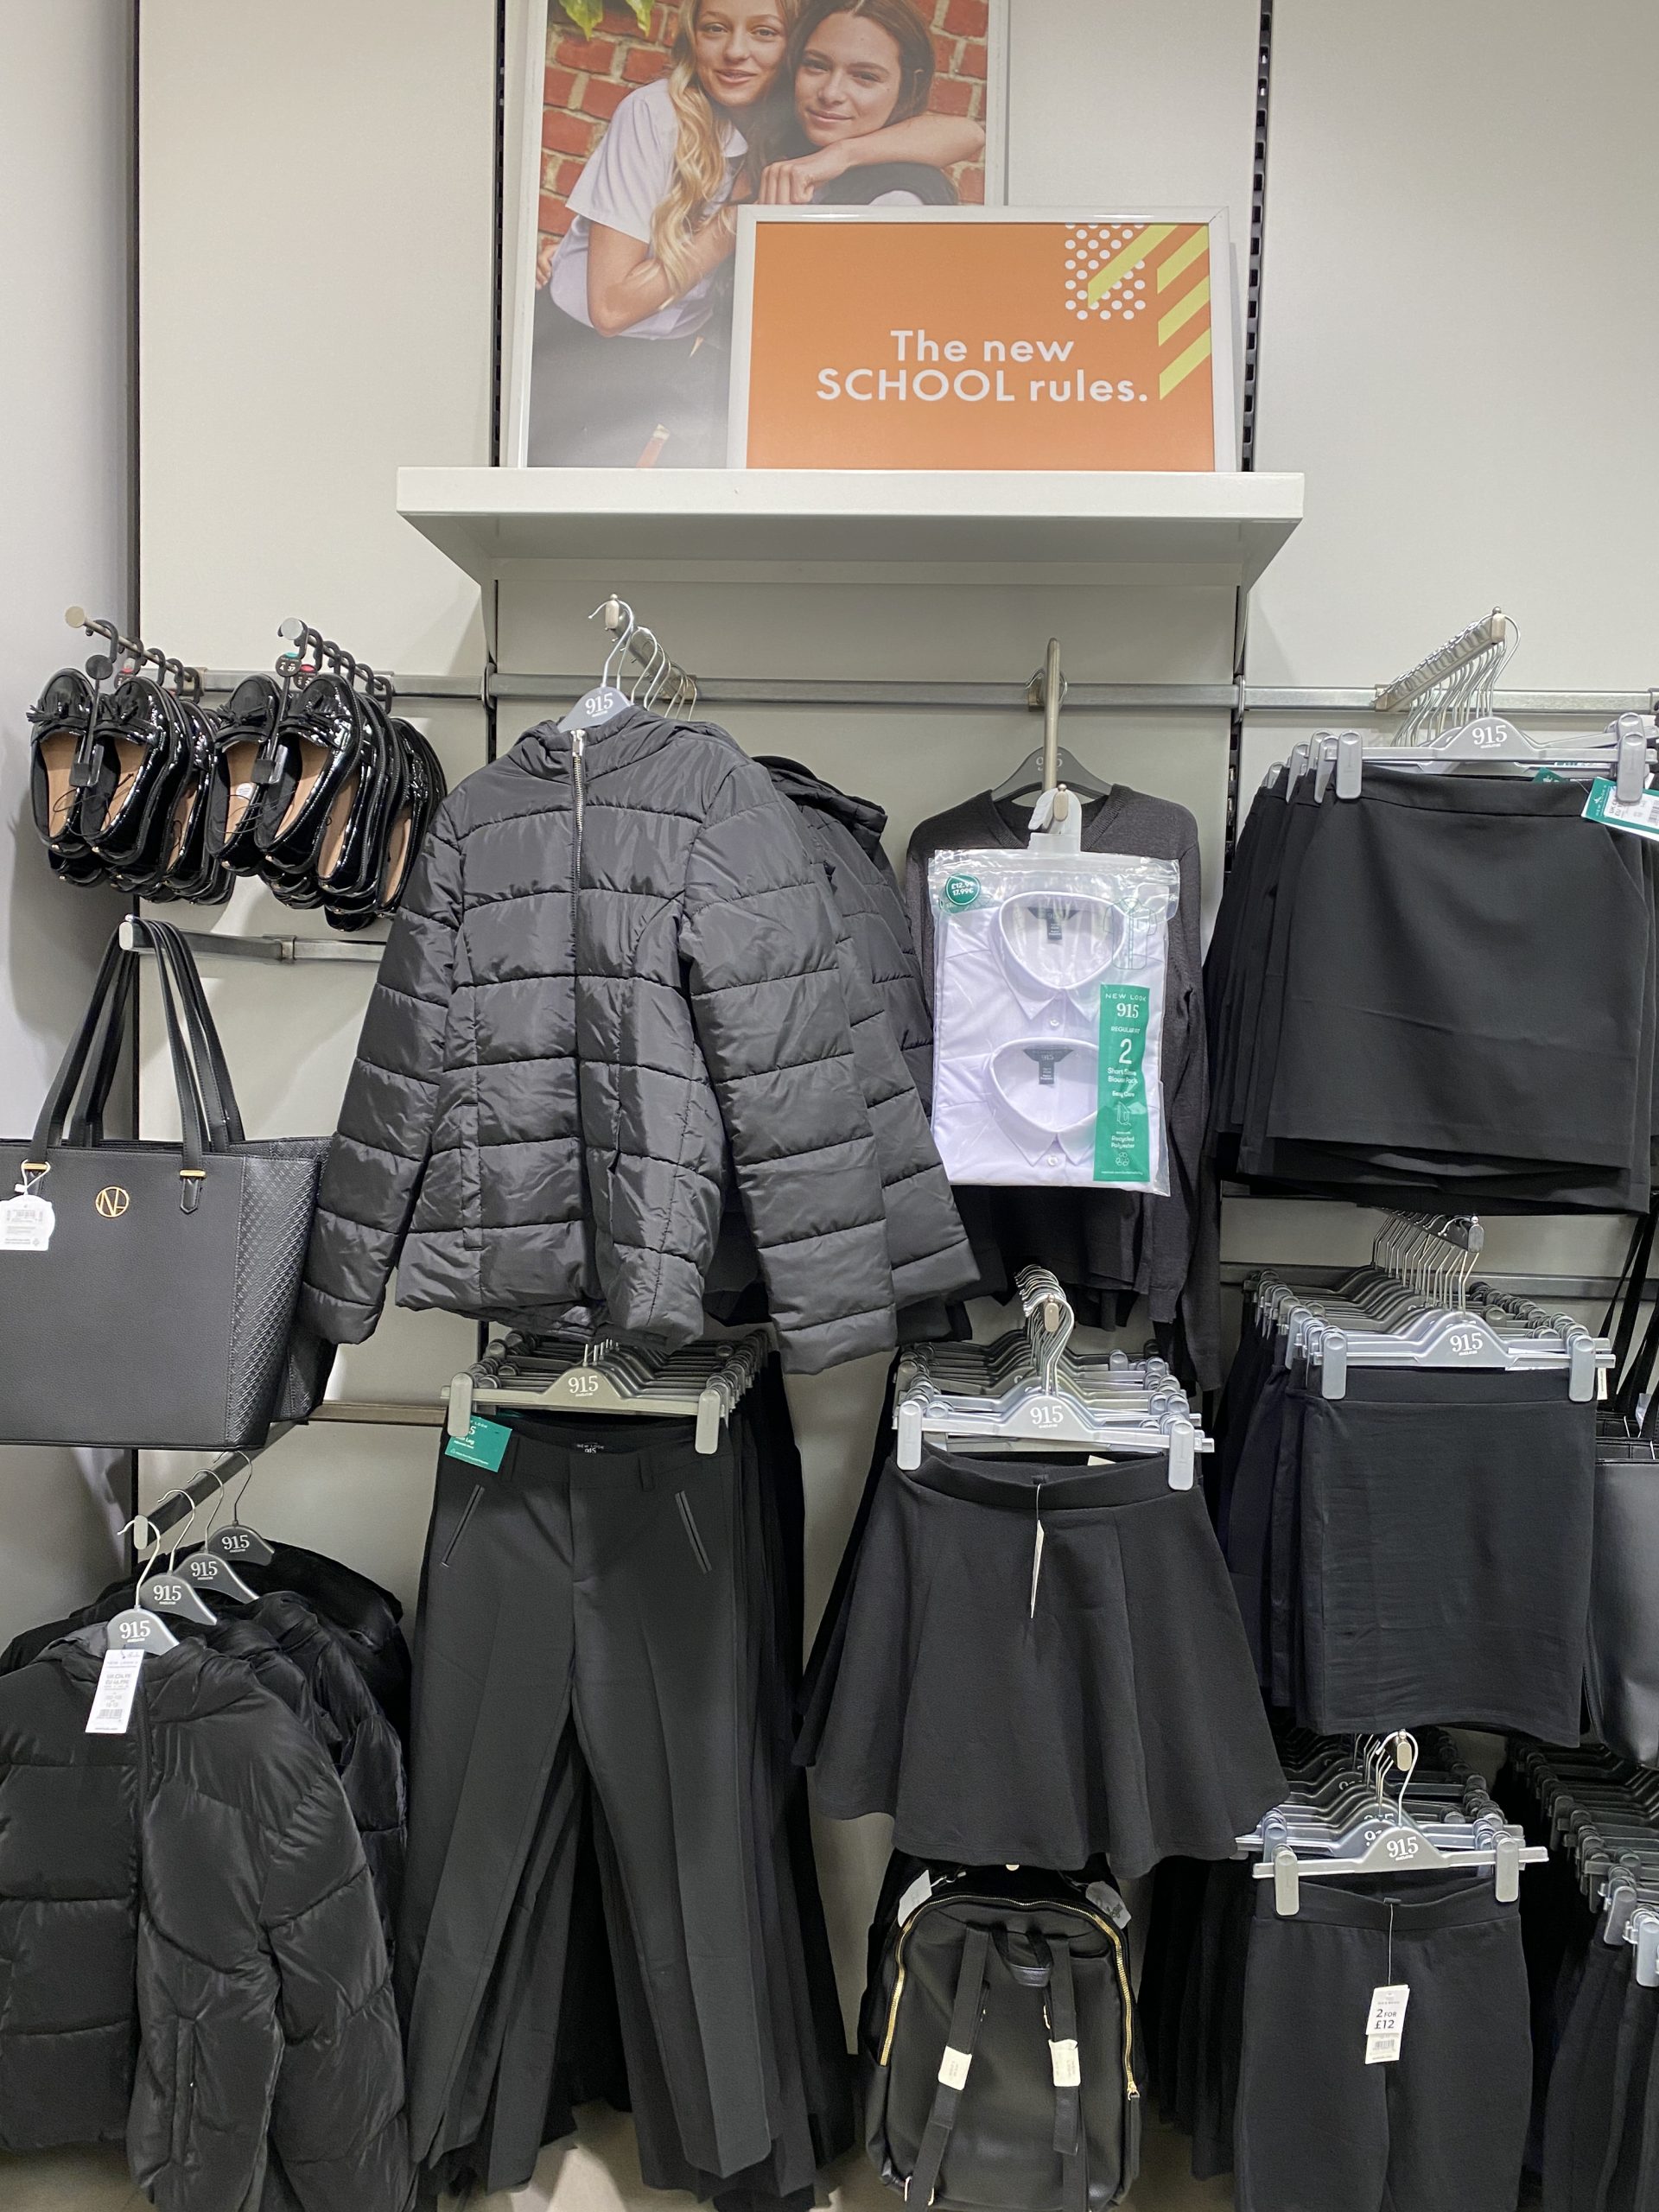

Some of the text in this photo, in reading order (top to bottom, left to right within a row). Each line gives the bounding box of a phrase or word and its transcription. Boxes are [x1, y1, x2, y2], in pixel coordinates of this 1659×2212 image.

[890, 330, 1074, 362] The new
[817, 369, 1148, 402] SCHOOL rules.
[585, 692, 613, 715] 915
[1471, 724, 1508, 745] 915
[1116, 1002, 1140, 1019] 915
[1119, 1039, 1132, 1065] 2
[1107, 1067, 1123, 1076] Short
[1450, 1332, 1484, 1352] 915
[568, 1375, 599, 1394] 915
[1030, 1405, 1064, 1425] 915
[221, 1535, 250, 1550] 915
[190, 1560, 218, 1577] 915
[153, 1585, 181, 1601] 915
[119, 1620, 150, 1639] 915
[1386, 1835, 1419, 1858] 915
[1376, 2008, 1383, 2018] 2
[1374, 2019, 1395, 2030] £12
